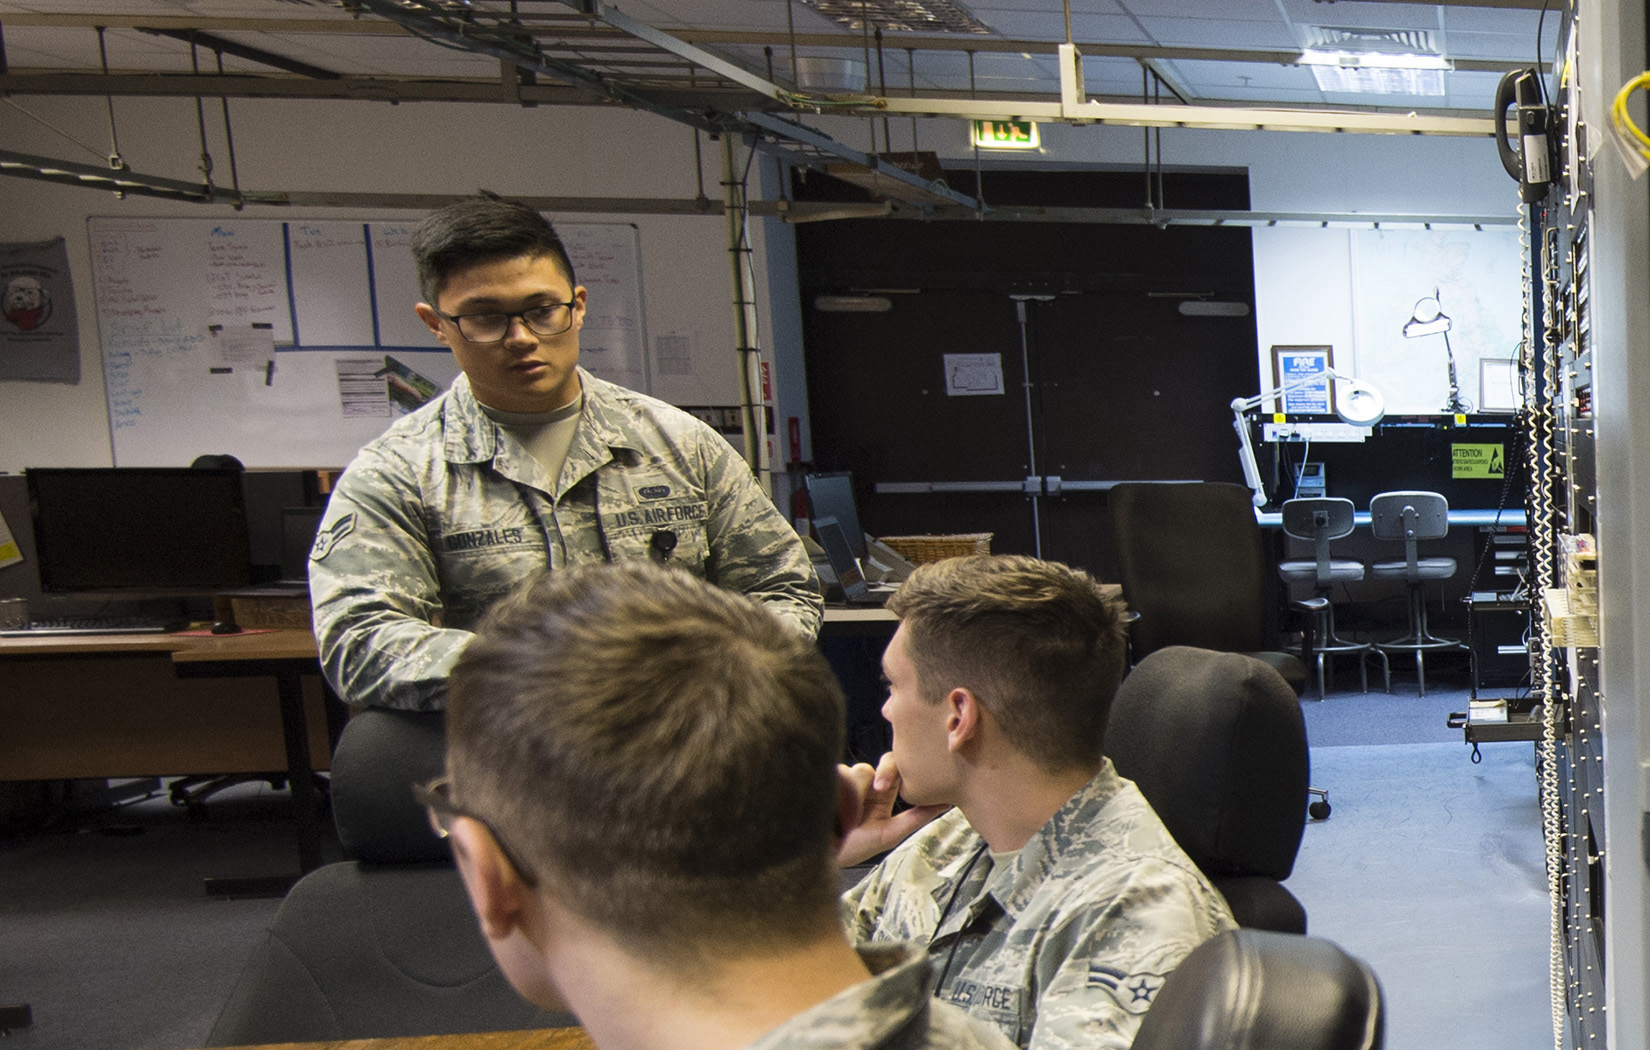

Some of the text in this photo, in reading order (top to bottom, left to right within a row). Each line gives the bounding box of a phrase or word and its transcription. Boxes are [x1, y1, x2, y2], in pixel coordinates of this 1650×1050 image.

[1293, 357, 1315, 367] FIRE
[1453, 449, 1482, 457] ATTENTION
[615, 504, 705, 528] U.S. AIR FORCE
[446, 528, 523, 550] GONZALES
